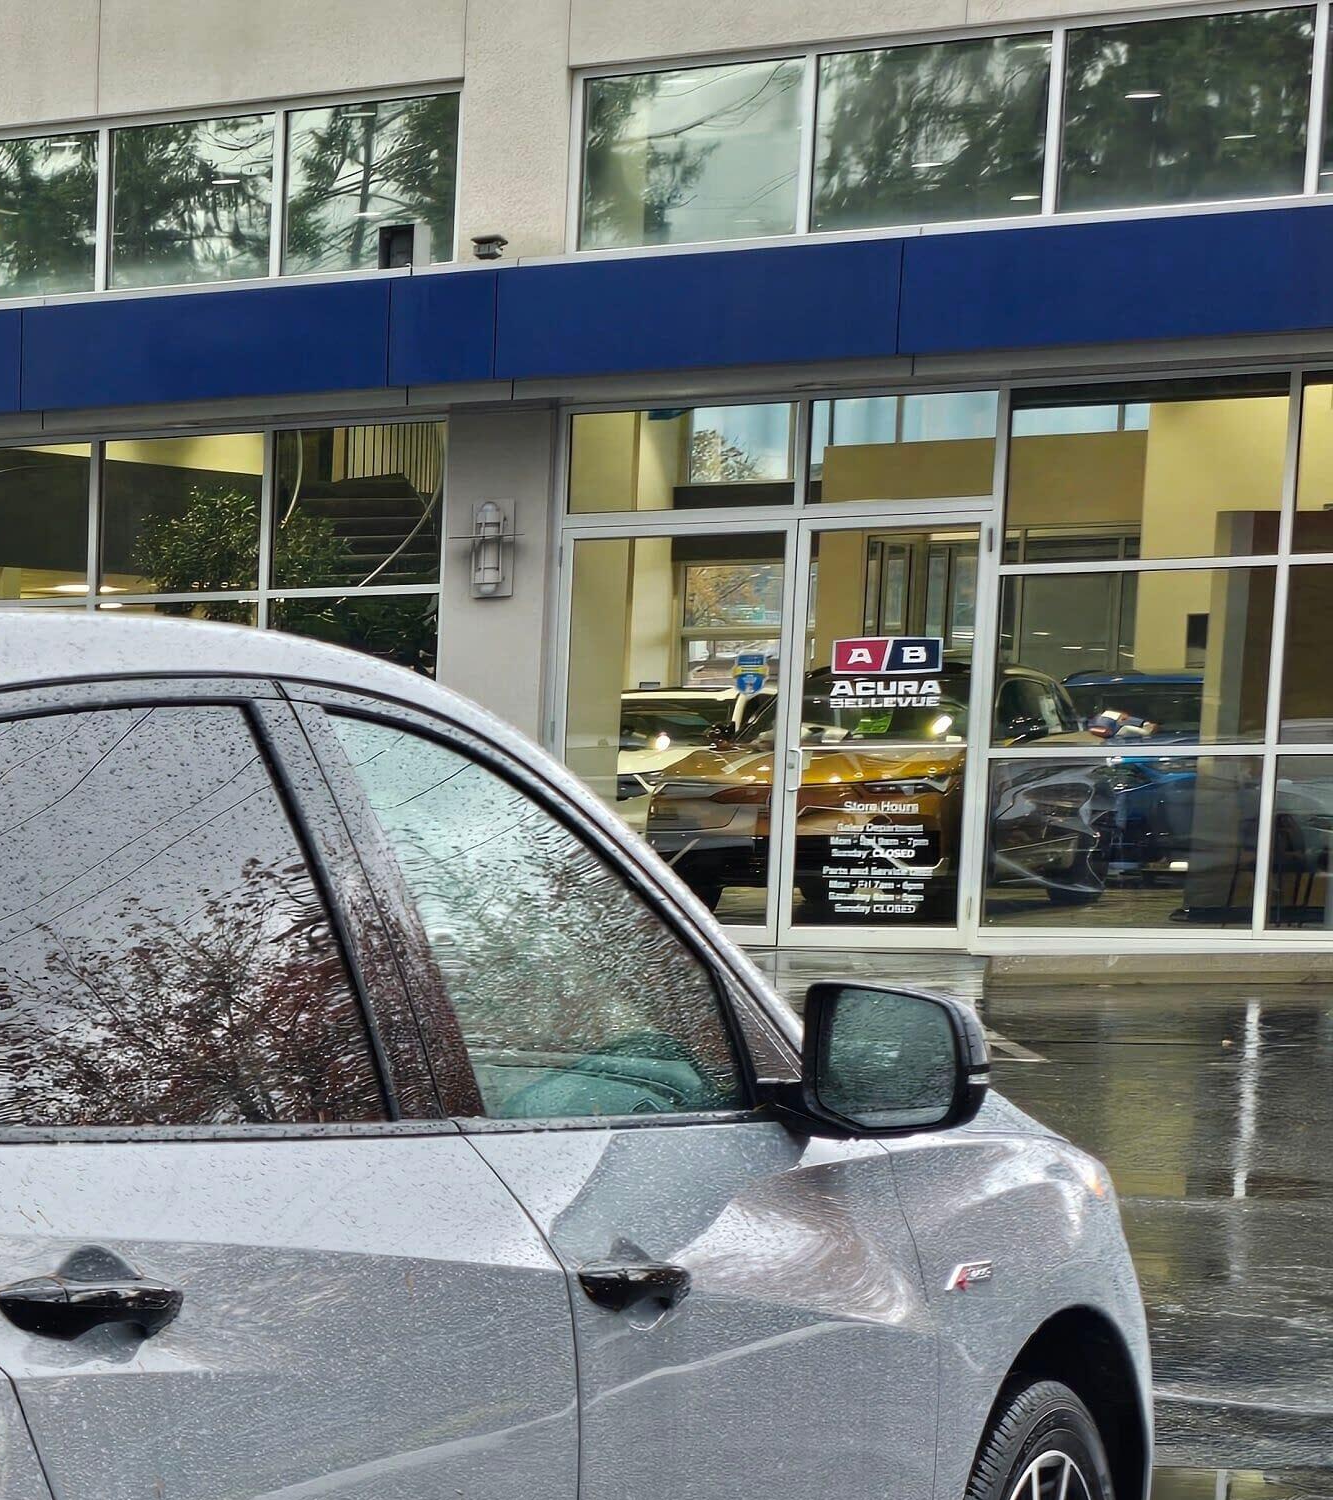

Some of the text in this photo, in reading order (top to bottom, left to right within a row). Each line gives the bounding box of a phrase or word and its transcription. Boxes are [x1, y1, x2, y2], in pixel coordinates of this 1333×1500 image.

[847, 646, 926, 664] A B
[830, 680, 941, 696] ACURA
[829, 696, 941, 708] BELLEVUE
[872, 849, 915, 858] CLOSED
[873, 904, 916, 913] CLOSED
